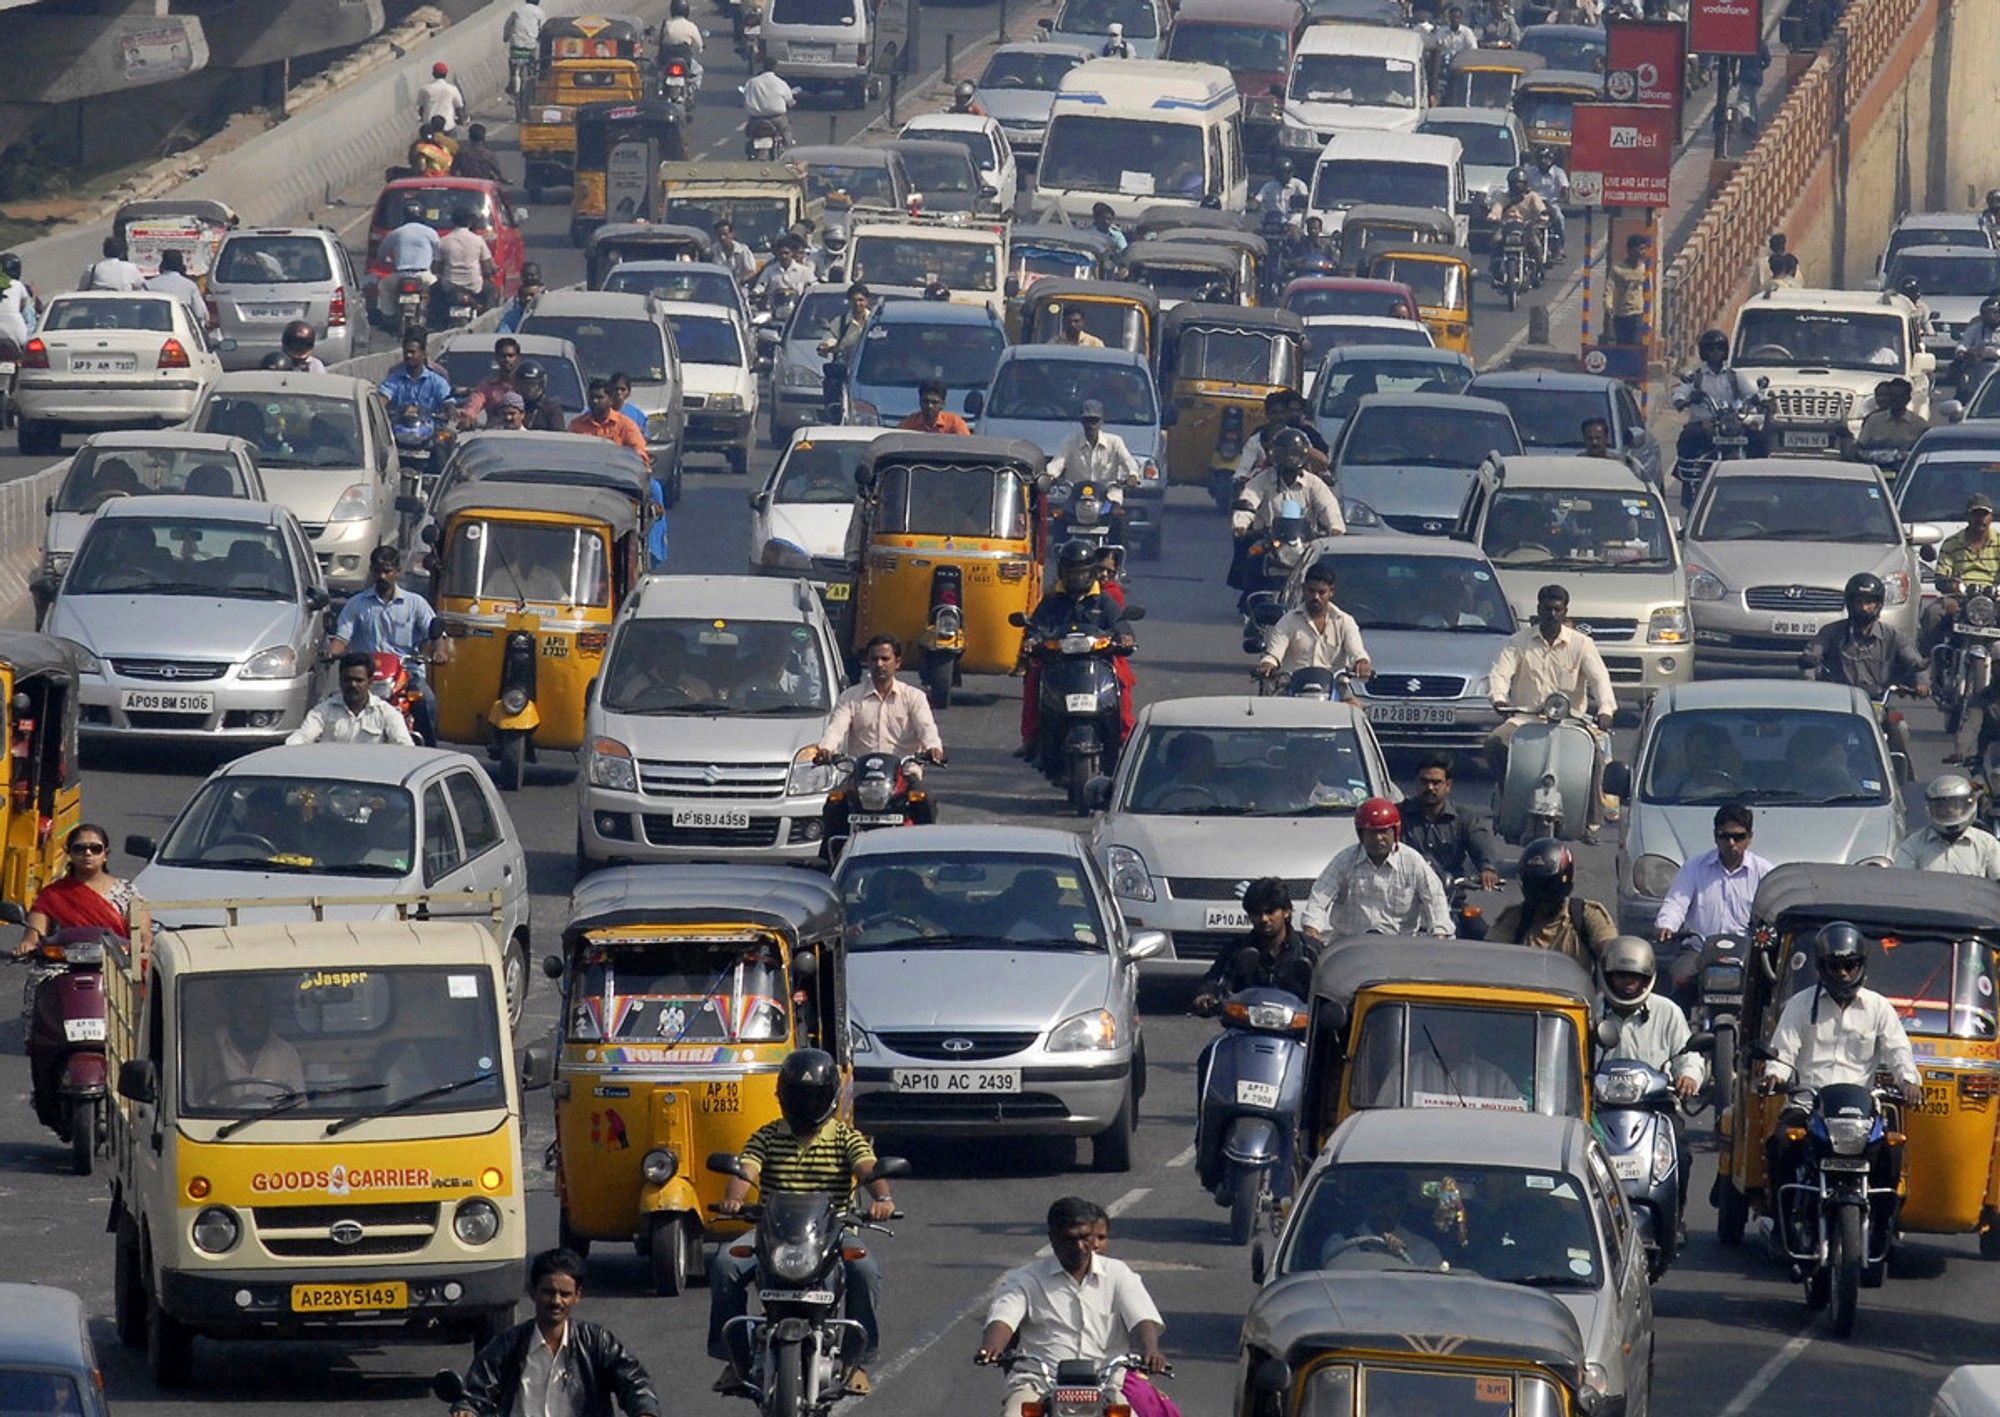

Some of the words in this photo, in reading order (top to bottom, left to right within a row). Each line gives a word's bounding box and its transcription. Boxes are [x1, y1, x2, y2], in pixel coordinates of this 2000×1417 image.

[1702, 5, 1750, 15] vodafone
[1612, 130, 1658, 148] Airtel
[1208, 913, 1235, 926] AP10
[313, 971, 368, 988] Jasper
[706, 1083, 722, 1096] AP
[725, 1082, 739, 1096] 10
[899, 1074, 939, 1090] AP10
[947, 1074, 970, 1090] AC
[978, 1074, 1014, 1090] 2439
[713, 1100, 740, 1113] 2832
[251, 1170, 330, 1192] GOODS
[348, 1168, 430, 1189] CARRIER
